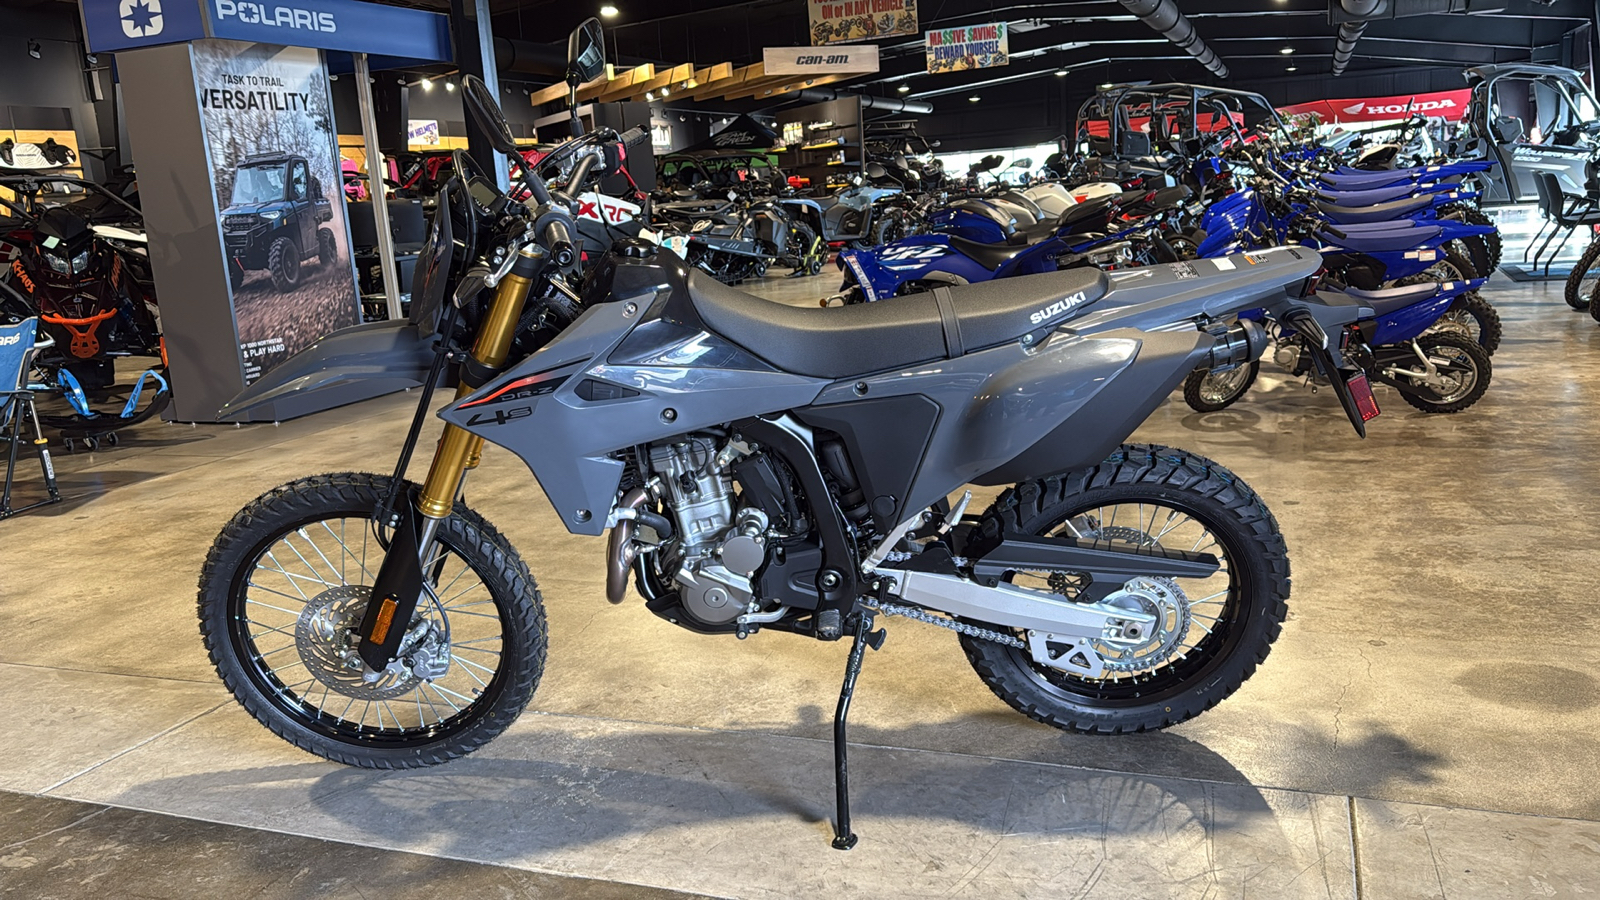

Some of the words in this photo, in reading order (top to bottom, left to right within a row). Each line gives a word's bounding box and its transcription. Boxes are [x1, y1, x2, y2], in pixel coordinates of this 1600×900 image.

[215, 0, 337, 33] POLARIS
[822, 5, 833, 20] ON
[844, 2, 853, 17] IN
[854, 0, 870, 15] ANY
[871, 0, 904, 13] VEHICLE
[934, 43, 965, 60] REWARD
[965, 40, 999, 56] YOURSELF
[796, 54, 849, 66] can-am
[222, 74, 245, 86] TASK
[246, 75, 258, 86] TO
[259, 76, 284, 87] TRAIL
[200, 88, 309, 112] VERSATILITY
[1366, 99, 1457, 115] HONDA
[12, 259, 36, 294] KHAOS
[1030, 291, 1087, 324] SUZUKI
[257, 337, 283, 346] NORTHSTAR
[243, 350, 249, 359] &
[250, 346, 266, 357] PLAY
[267, 343, 285, 354] HARD
[501, 386, 553, 401] DR-Z
